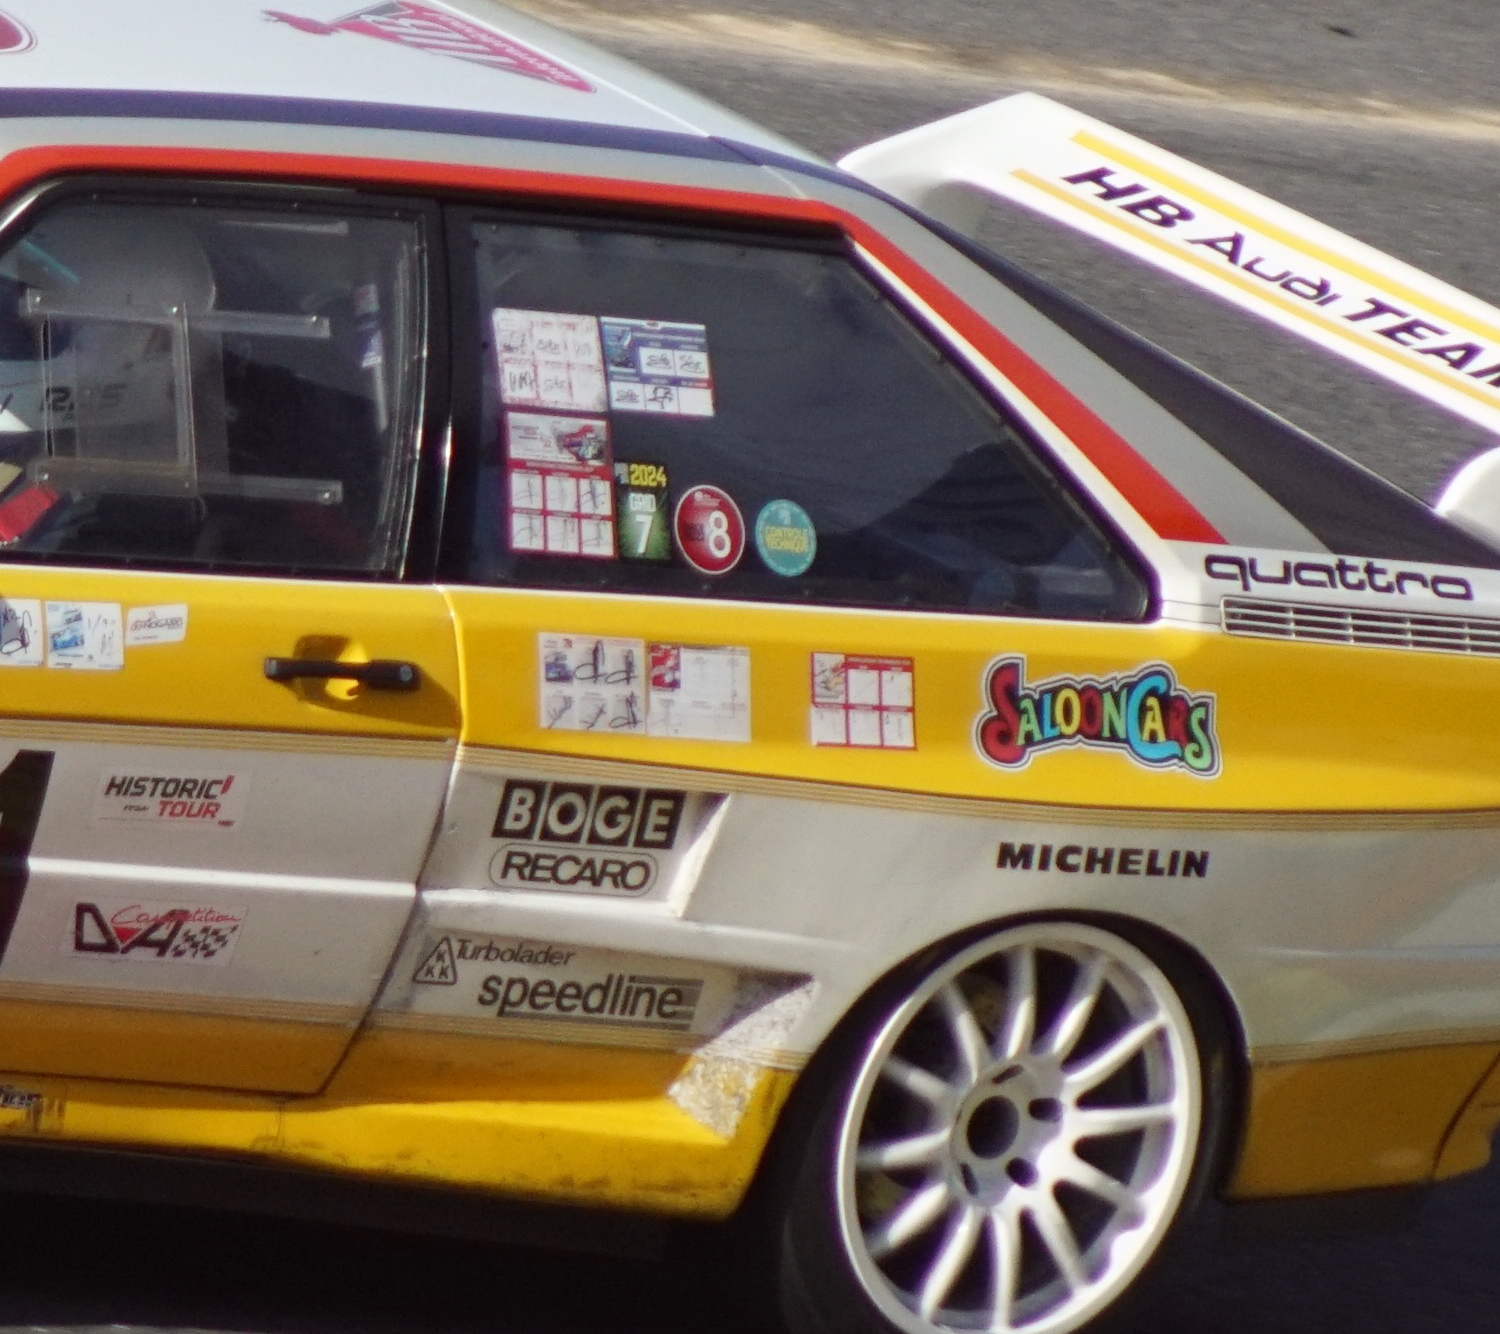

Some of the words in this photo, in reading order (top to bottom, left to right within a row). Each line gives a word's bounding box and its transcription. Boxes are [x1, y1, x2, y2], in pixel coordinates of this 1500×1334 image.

[1060, 166, 1196, 228] HB
[629, 463, 667, 487] 2024
[635, 514, 653, 554] 7
[709, 510, 731, 558] 8
[1204, 553, 1473, 601] quattro
[158, 800, 221, 818] TOUR
[503, 787, 676, 843] BOGE
[501, 850, 650, 891] RECARO
[997, 842, 1209, 879] MICHELIN
[457, 938, 577, 965] Turbolader
[478, 972, 684, 1017] speedline
